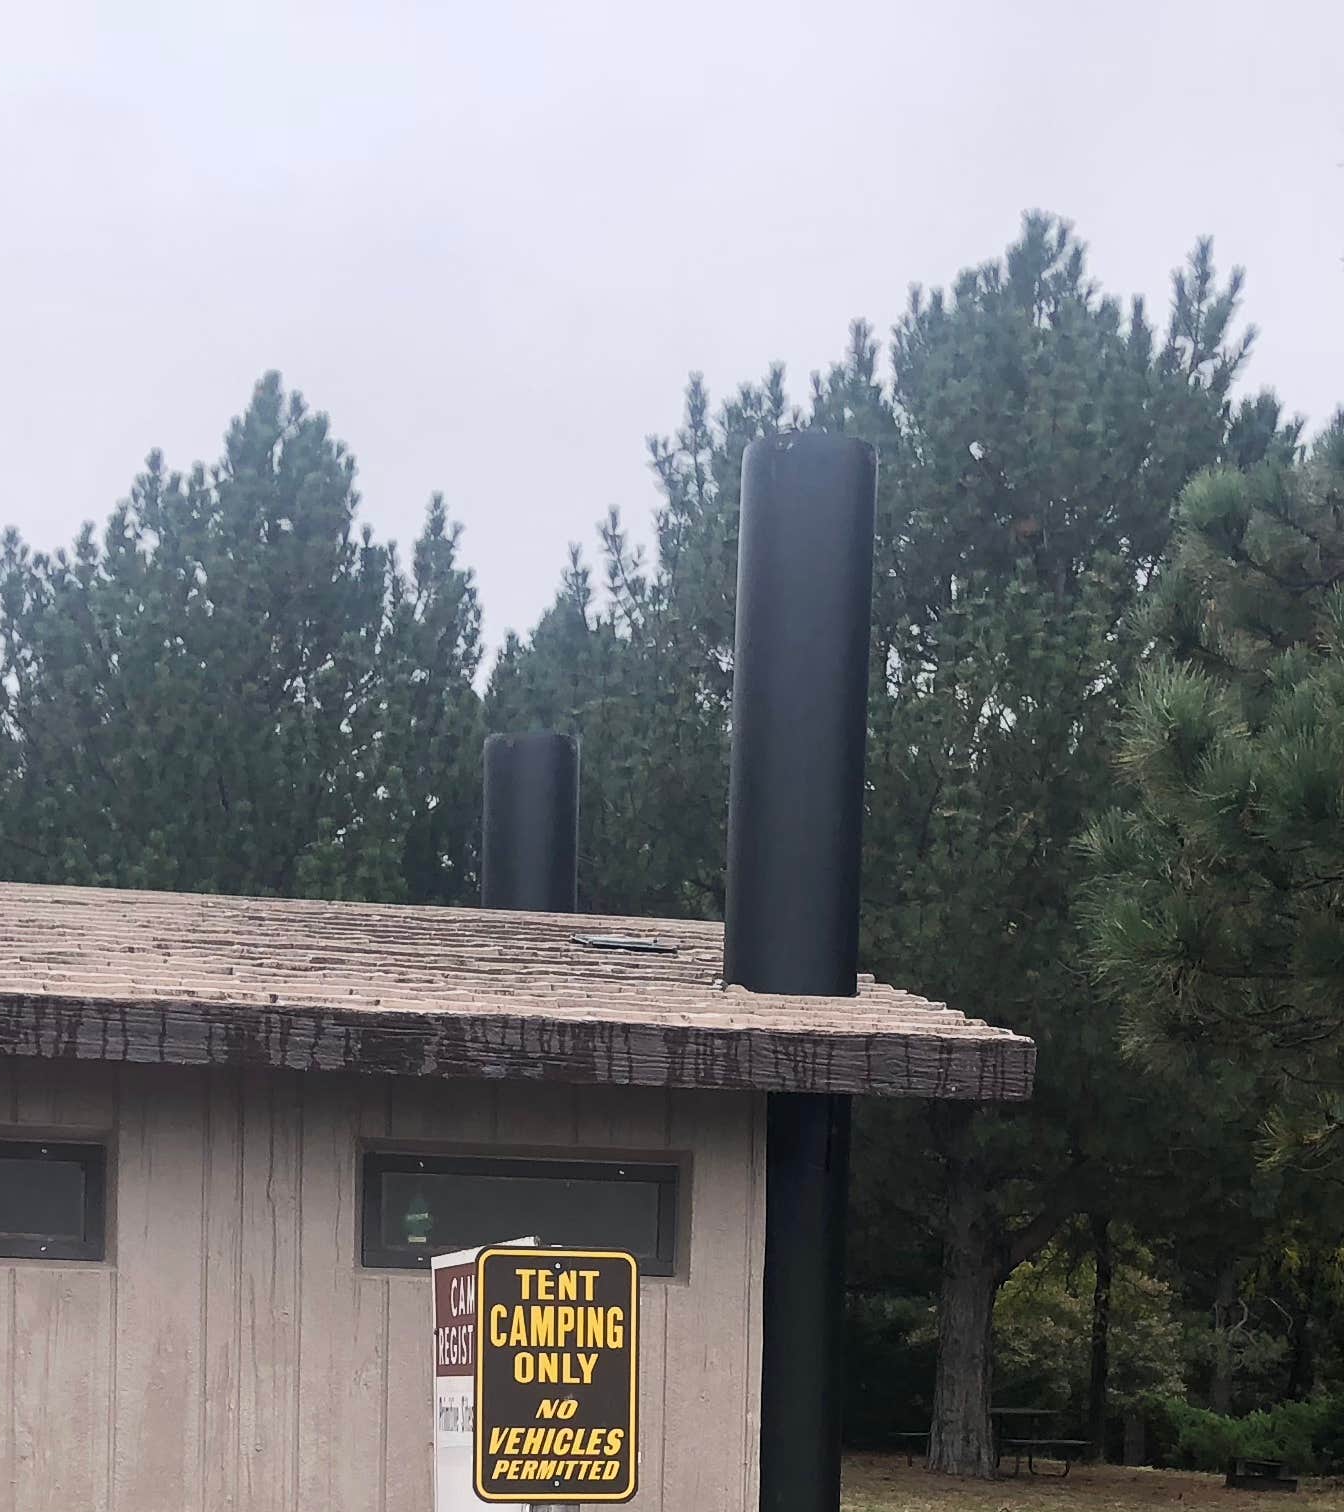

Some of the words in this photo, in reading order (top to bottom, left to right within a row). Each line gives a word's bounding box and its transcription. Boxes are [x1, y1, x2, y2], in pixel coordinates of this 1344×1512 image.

[515, 1268, 600, 1301] TENT
[490, 1304, 624, 1349] CAMPING
[514, 1352, 599, 1384] ONLY
[535, 1398, 578, 1420] NO
[488, 1427, 625, 1456] VEHICLES
[491, 1459, 620, 1480] PERMITTED
